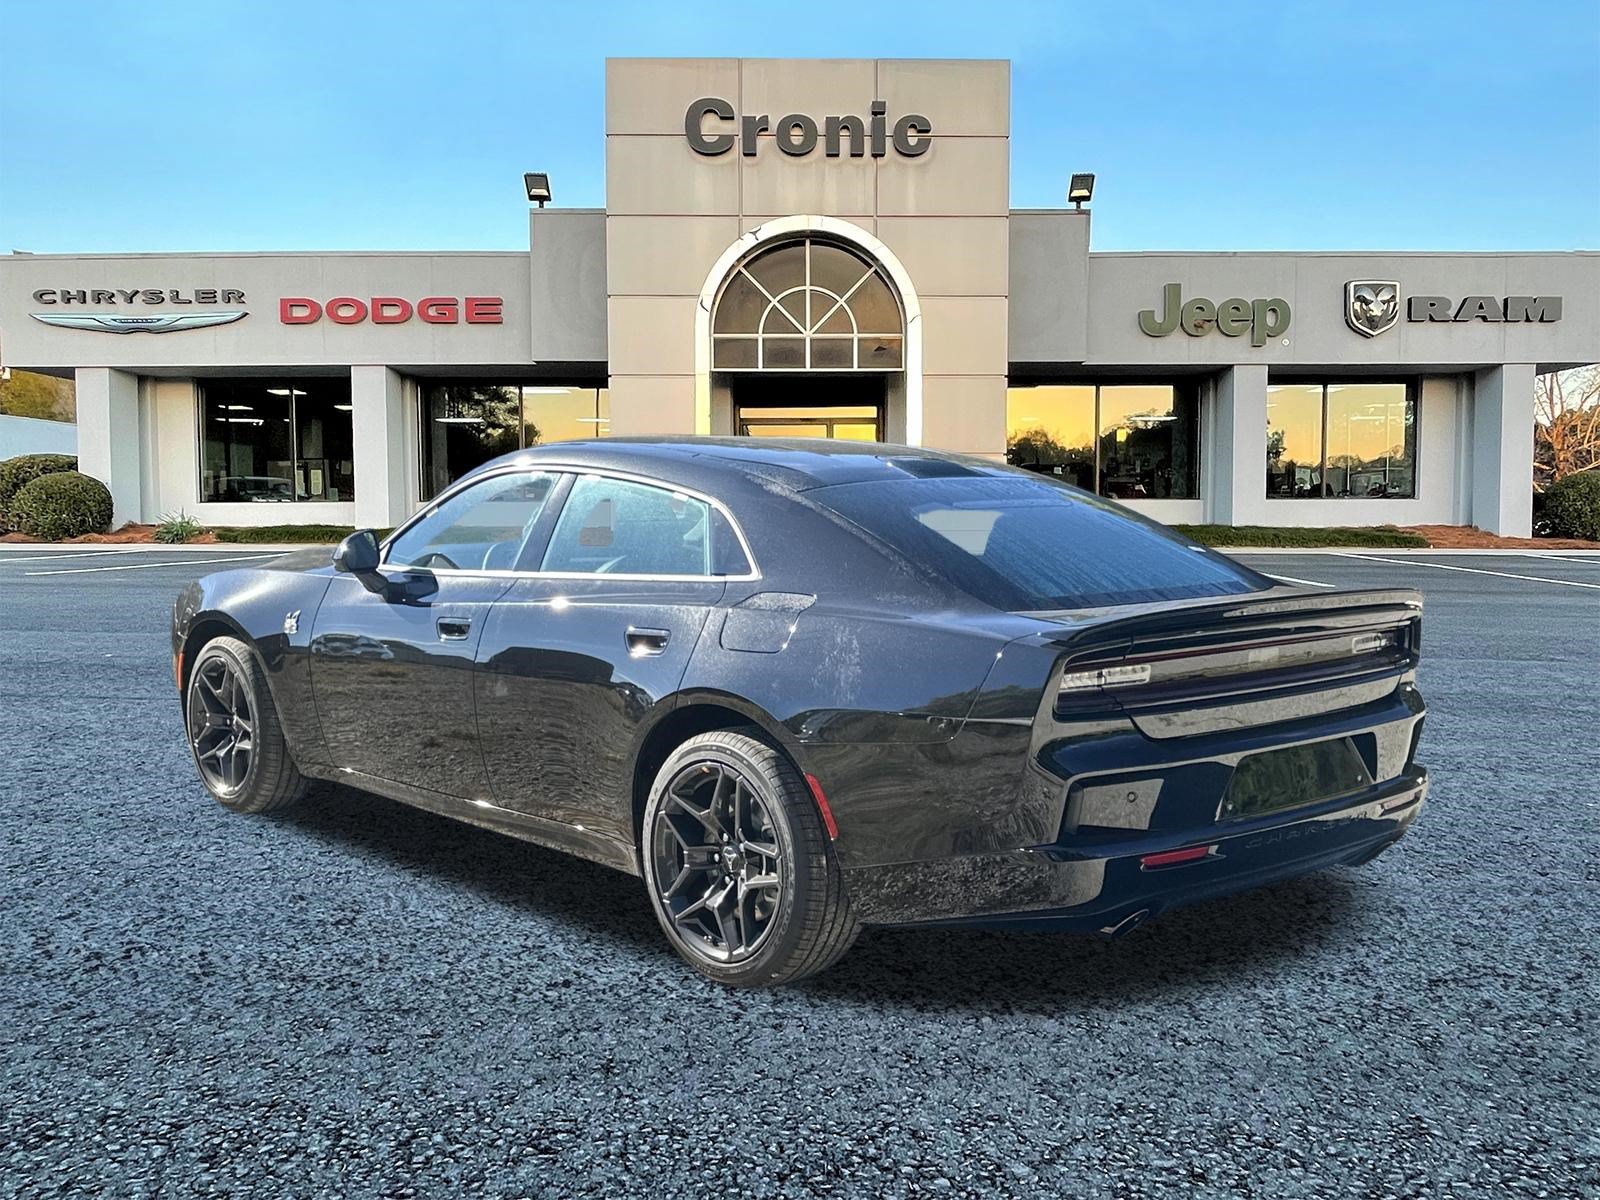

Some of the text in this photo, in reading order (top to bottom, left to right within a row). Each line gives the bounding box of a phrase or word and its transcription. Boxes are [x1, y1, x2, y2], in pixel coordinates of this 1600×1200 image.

[685, 97, 932, 157] Cronic
[32, 288, 247, 304] CHRYSLER
[1407, 296, 1562, 322] RAM
[280, 297, 503, 324] DODGE
[1138, 283, 1291, 347] Jeep
